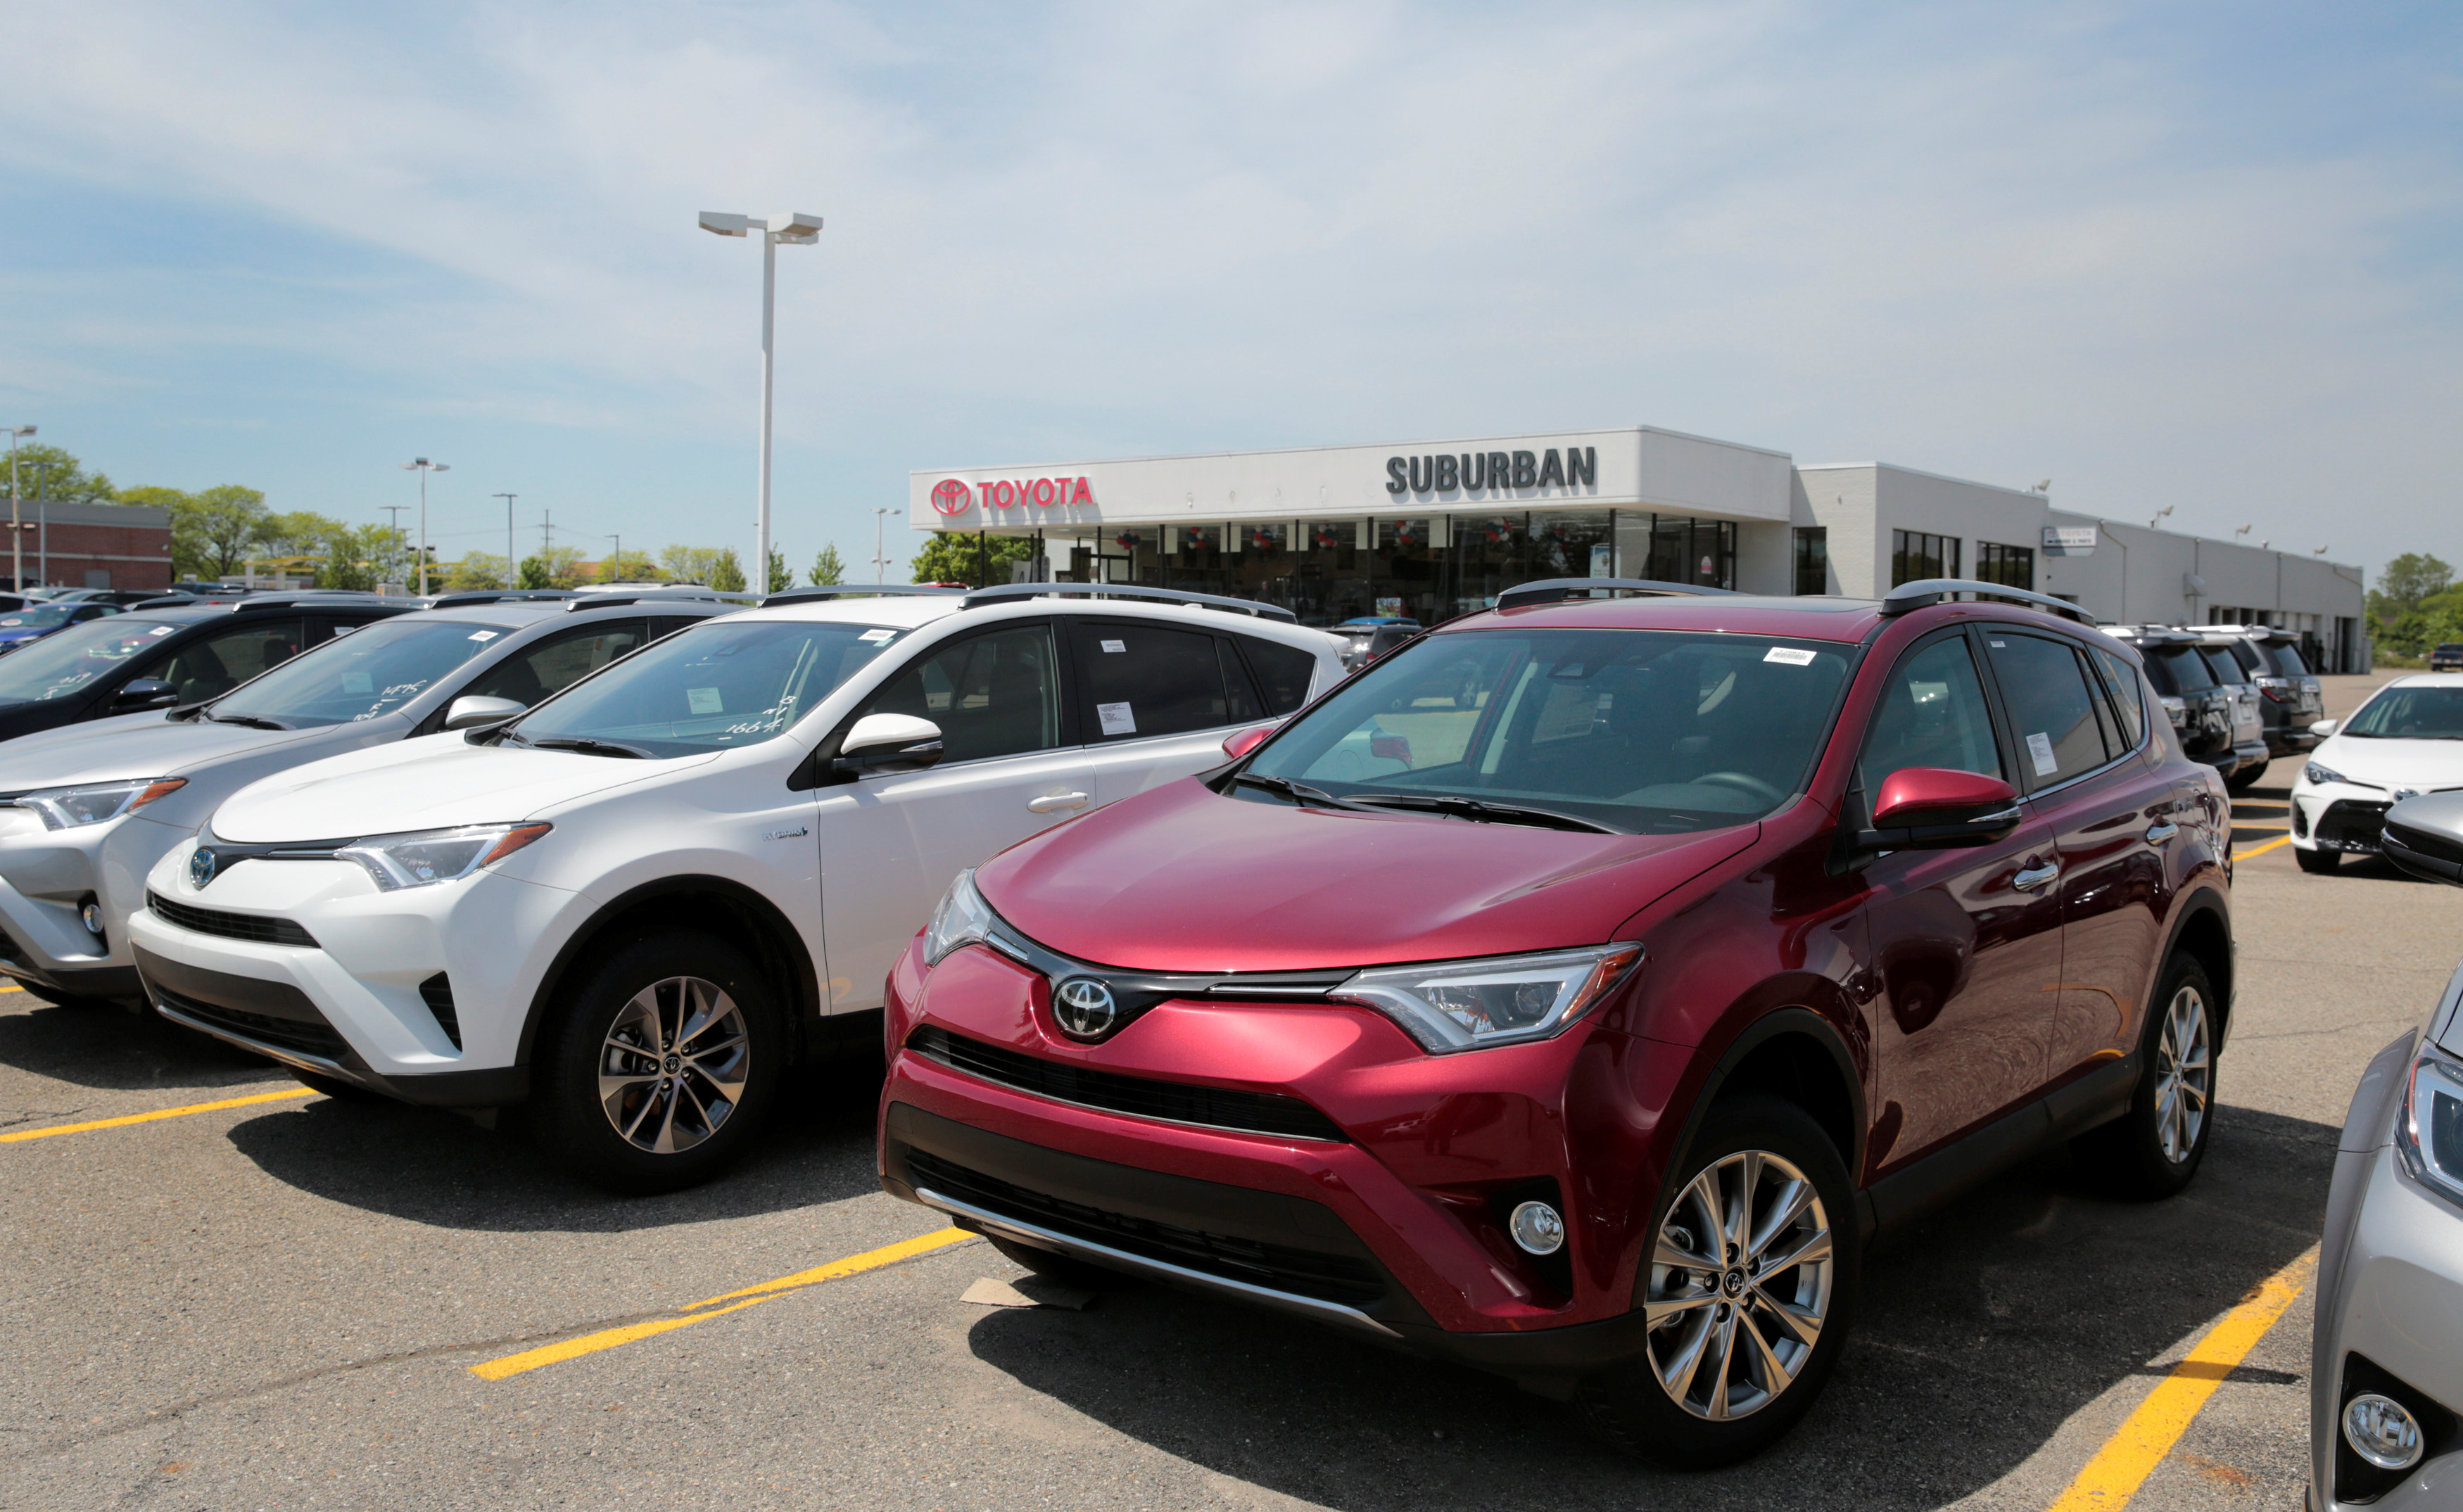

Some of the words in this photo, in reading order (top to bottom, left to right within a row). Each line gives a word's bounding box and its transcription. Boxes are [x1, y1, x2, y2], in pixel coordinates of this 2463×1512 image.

[1386, 447, 1595, 494] SUBURBAN
[977, 476, 1094, 509] TOYOTA
[725, 718, 784, 734] 1664
[762, 830, 802, 841] HYBRID
